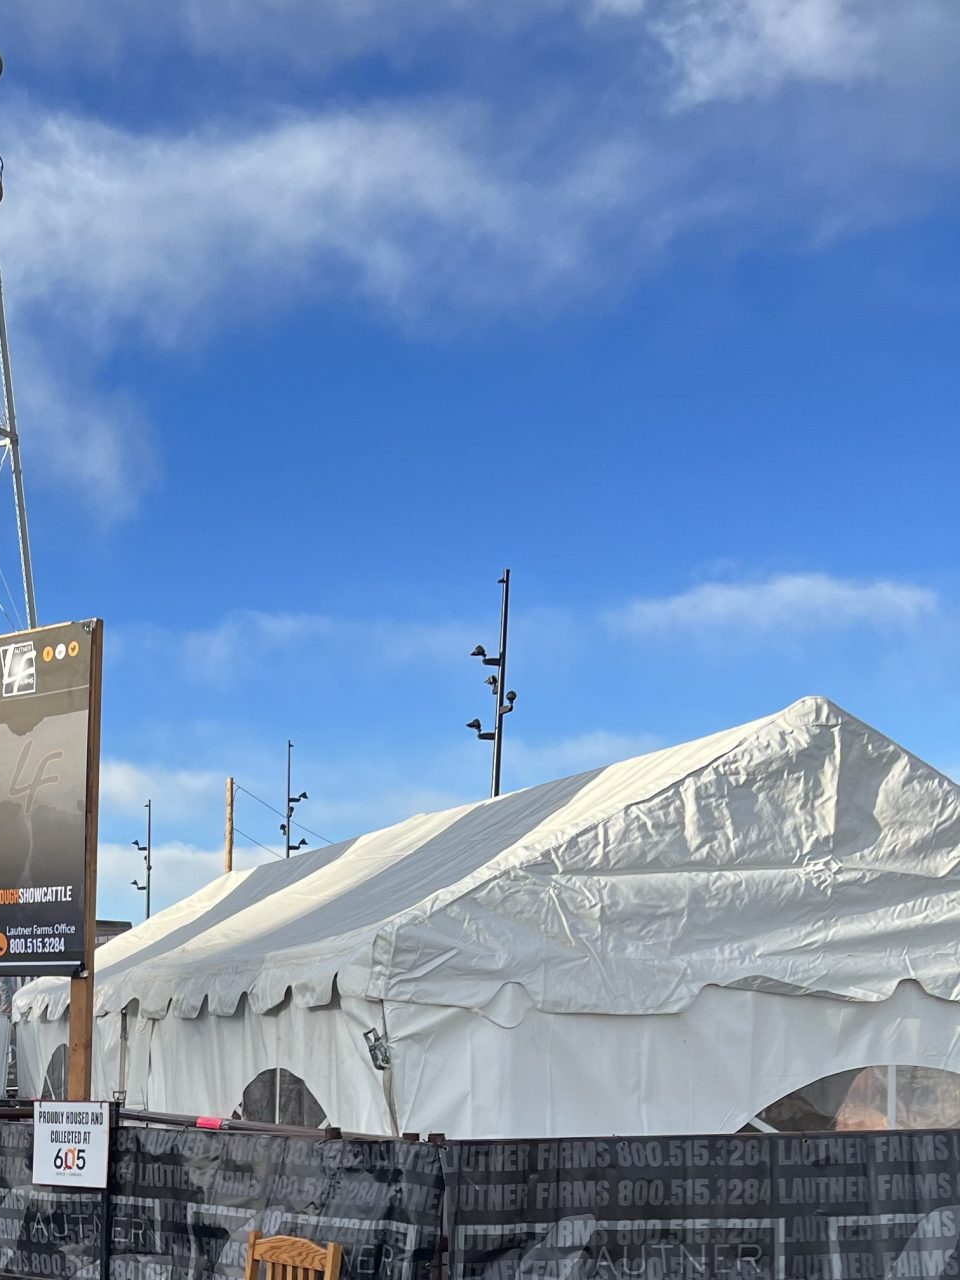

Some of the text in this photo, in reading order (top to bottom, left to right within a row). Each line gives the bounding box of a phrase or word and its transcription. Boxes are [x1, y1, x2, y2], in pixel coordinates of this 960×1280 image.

[6, 923, 76, 936] Lautner Farms Office
[9, 937, 65, 954] 800.515.3284
[38, 1110, 104, 1126] PROUDLY HOUSED AND
[50, 1130, 91, 1145] COLLECTED AT
